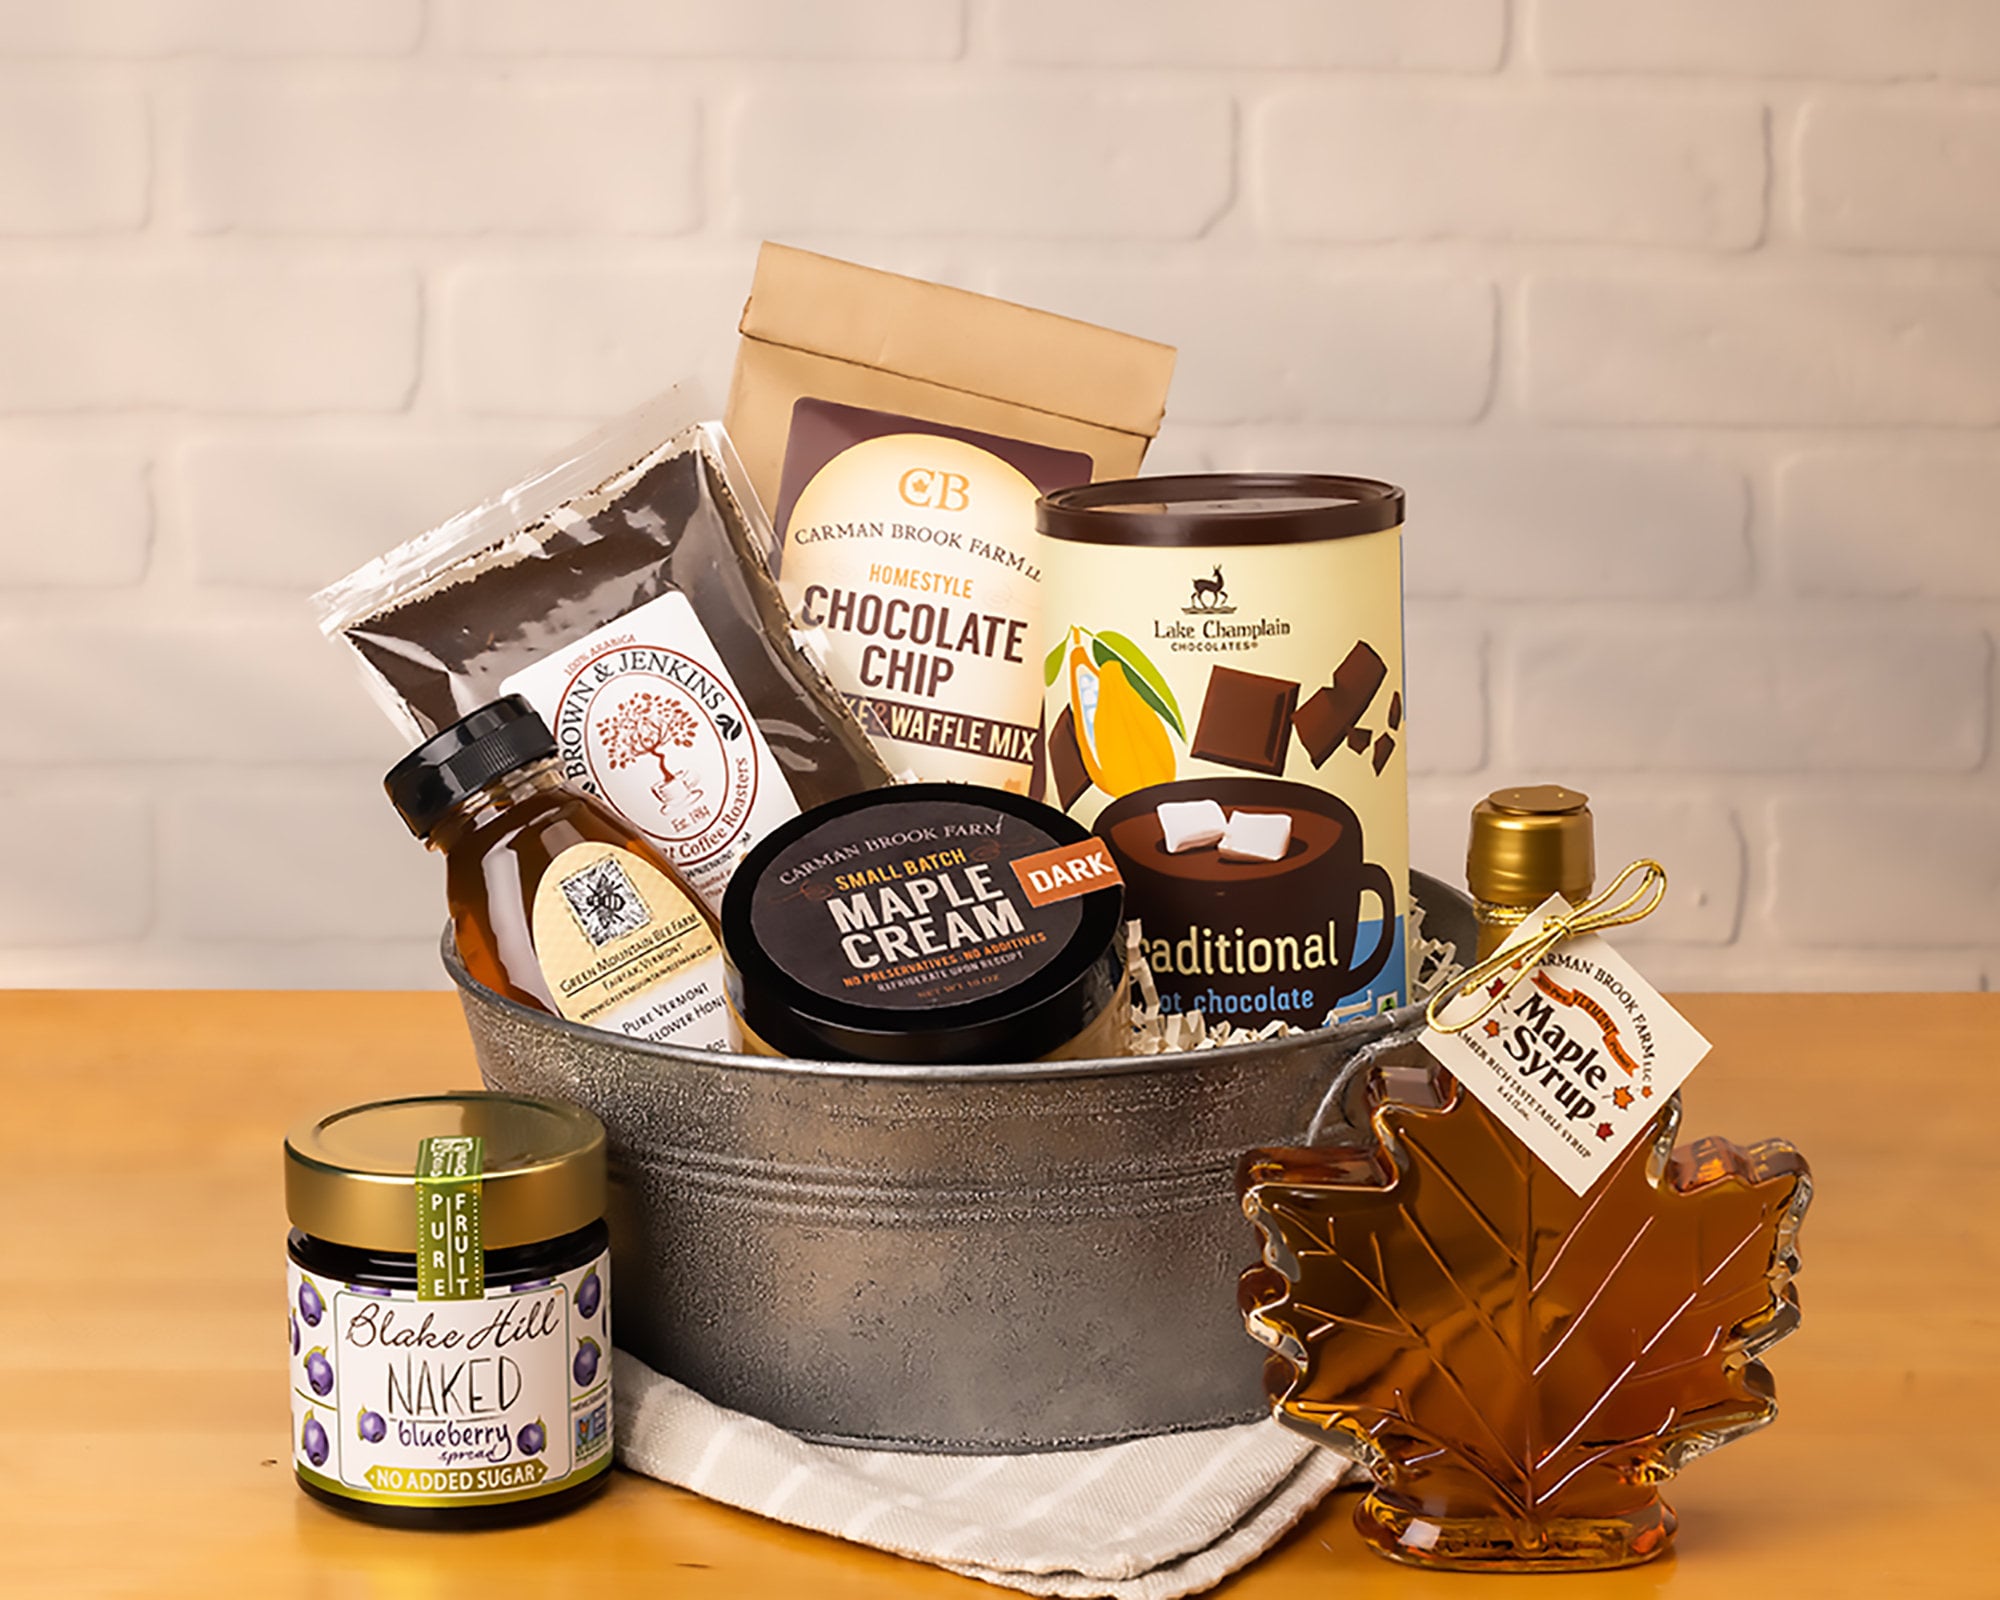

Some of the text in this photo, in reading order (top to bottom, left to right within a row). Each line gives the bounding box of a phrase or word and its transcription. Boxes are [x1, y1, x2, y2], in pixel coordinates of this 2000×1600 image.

[794, 522, 1041, 583] CARMAN BROOK FARM LL
[869, 563, 973, 599] HOMESTYLE
[590, 634, 637, 657] ARABICA
[802, 585, 1028, 664] CHOCOLATE
[1154, 618, 1291, 640] Lake Champlain
[860, 645, 954, 698] CHIP
[561, 650, 726, 780] BROWN & JENKINS
[891, 705, 985, 751] WAFFLE
[988, 729, 1038, 762] MIX
[679, 829, 727, 859] Coffee
[724, 756, 749, 830] Roasters
[780, 821, 1002, 886] CARMAN BROOK FARM
[834, 848, 967, 892] SMALL BATCH
[1027, 852, 1114, 894] DARK
[826, 863, 1004, 934] MAPLE
[597, 937, 654, 971] MOUNTAIN
[840, 898, 1026, 970] CREAM
[842, 932, 1047, 988] NO PRESERVATIVES NO ADDITIVES
[1139, 921, 1338, 975] raditional
[950, 963, 980, 976] UPON
[981, 951, 1024, 969] RECEIPT
[622, 982, 710, 1035] PURE VERMONT
[1160, 985, 1314, 1014] ot chocolate
[1594, 968, 1639, 1014] BROOK
[1632, 1014, 1655, 1059] FARM
[645, 1013, 697, 1042] FLOWER
[1513, 992, 1607, 1090] Maple
[1503, 1025, 1596, 1121] Syrup
[1486, 1057, 1513, 1082] RICH
[1561, 1129, 1592, 1158] SYRUP
[431, 1193, 445, 1297] PURE
[455, 1192, 469, 1297] FRUIT
[346, 1297, 559, 1350] Blake Hill
[388, 1353, 522, 1416] NAKED
[398, 1421, 512, 1463] blueberry
[438, 1446, 498, 1466] spread
[377, 1464, 538, 1490] NO ADDED SUGAR
